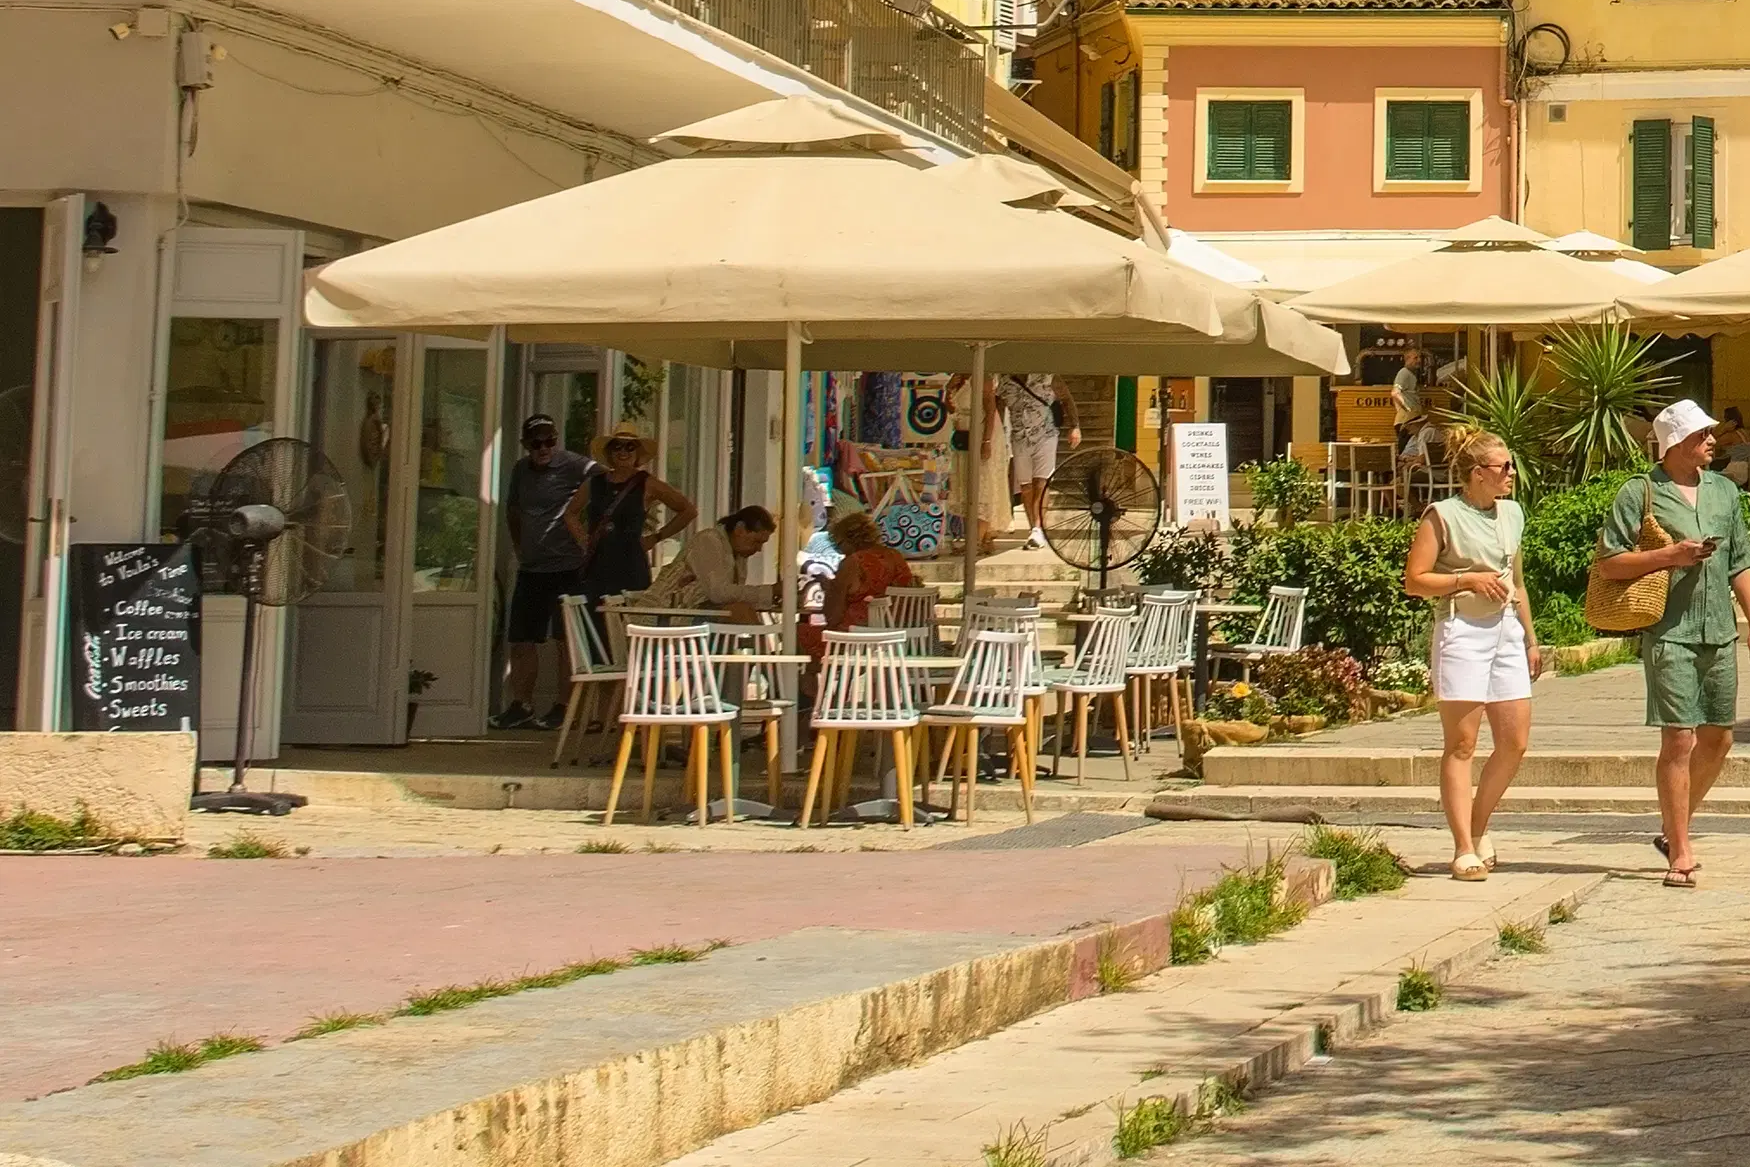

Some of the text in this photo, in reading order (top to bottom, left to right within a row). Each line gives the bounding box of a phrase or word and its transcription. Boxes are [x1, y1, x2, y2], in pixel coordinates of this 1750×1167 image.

[98, 572, 115, 587] to
[157, 564, 188, 580] Time
[115, 599, 164, 616] Coffee
[115, 623, 188, 641] Ice cream
[110, 645, 181, 670] Waffles
[108, 673, 189, 694] Smoothies
[108, 697, 168, 719] Sweets
